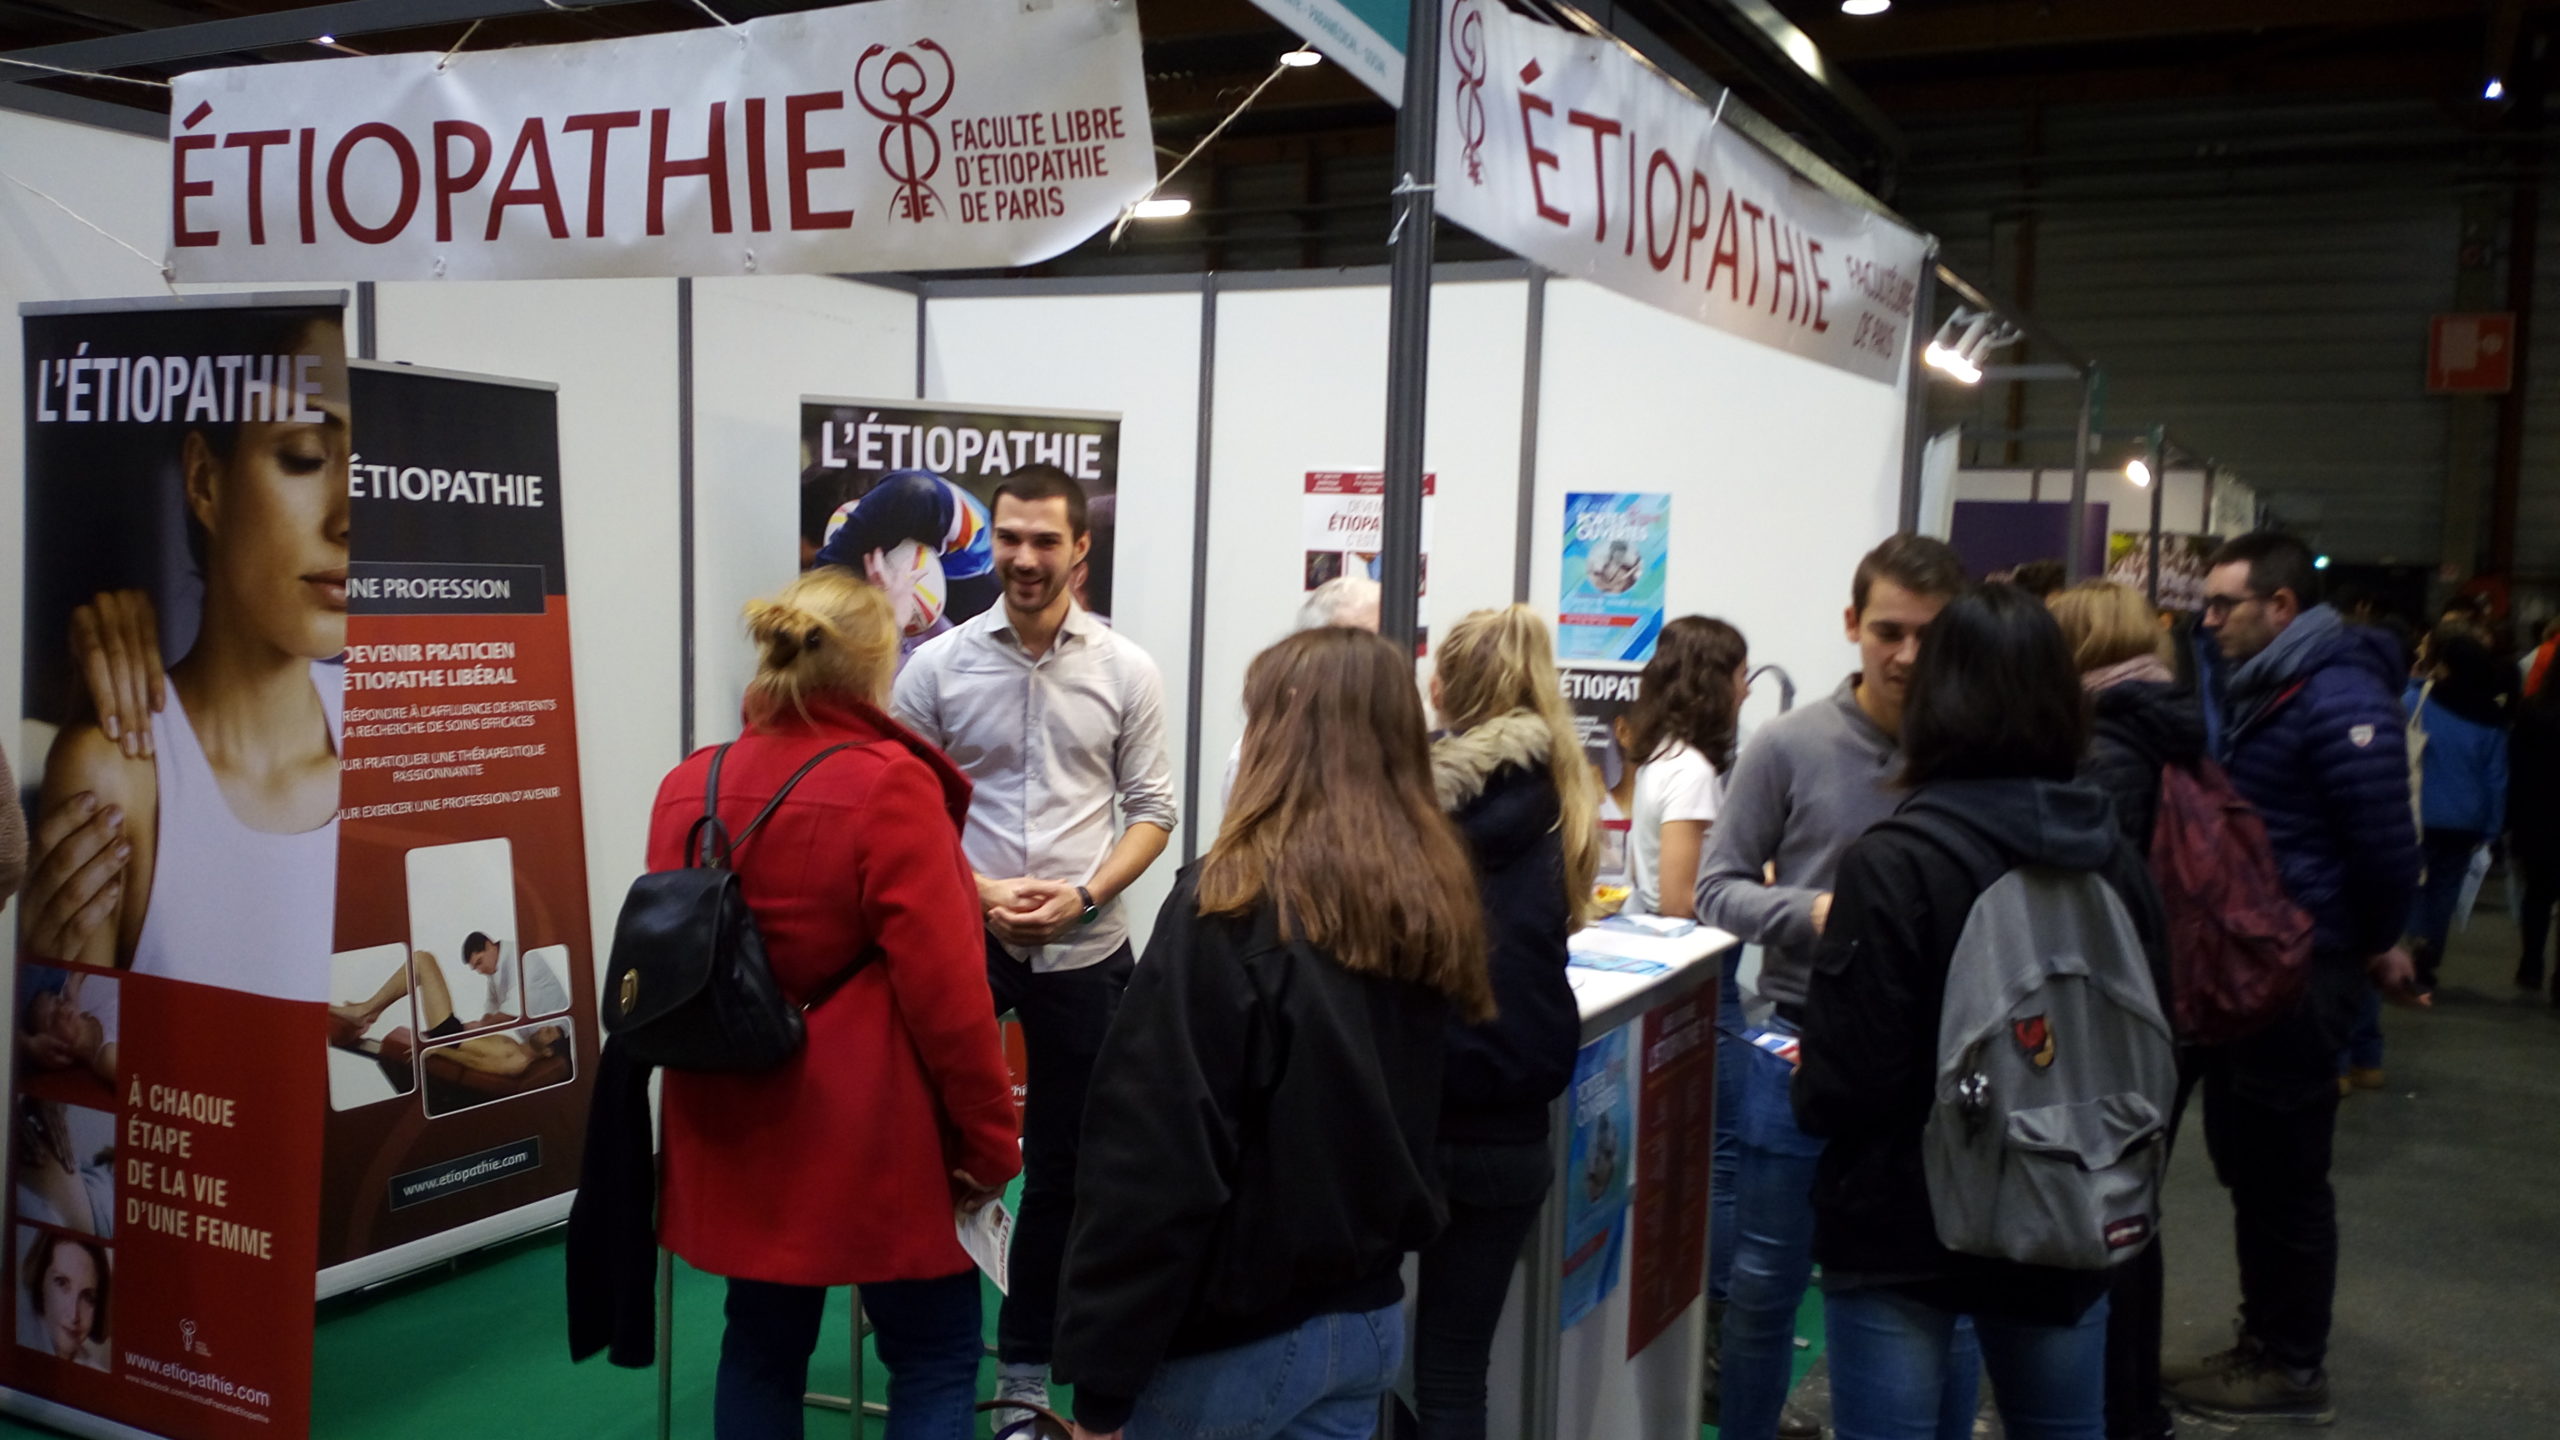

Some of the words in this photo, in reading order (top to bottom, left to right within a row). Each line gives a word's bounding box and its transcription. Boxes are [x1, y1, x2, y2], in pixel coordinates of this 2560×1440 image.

[1052, 106, 1125, 145] LIBRE
[173, 91, 855, 247] ÉTIOPATHIE
[960, 191, 989, 223] DE
[995, 186, 1065, 221] PARIS
[1518, 58, 1830, 333] ÉTIOPATHIE
[36, 342, 325, 424] L'ÉTIOPATHIE
[821, 411, 1102, 480] L'ÉTIOPATHIE
[1328, 511, 1381, 532] ÉTIOPA
[383, 577, 511, 600] PROFESSION
[425, 642, 516, 661] PRATICIEN
[447, 663, 518, 687] LIBÉRAL
[1559, 669, 1643, 702] ÉTIOPAT
[343, 707, 408, 722] RÉPONDRE
[493, 701, 509, 714] DE
[509, 699, 558, 713] PATIENTS
[356, 721, 425, 738] RECHERCHE
[427, 720, 444, 733] DE
[445, 718, 480, 732] SOINS
[481, 714, 536, 730] EFFICACES
[363, 753, 430, 769] PRATIQUER
[431, 750, 457, 764] UNE
[457, 743, 547, 761] THÉRAPEUTIQUE
[392, 763, 485, 783] PASSIONNANTE
[362, 801, 413, 819] EXERCER
[414, 798, 442, 812] UNE
[442, 792, 511, 810] PROFESSION
[149, 1084, 236, 1128] CHAQUE
[127, 1112, 192, 1159] ÉTAPE
[127, 1158, 155, 1190] DE
[160, 1166, 187, 1199] LA
[192, 1173, 228, 1208] VIE
[402, 1151, 529, 1197] www.etiopathie.com
[126, 1197, 189, 1239] D'UNE
[195, 1214, 273, 1261] FEMME
[125, 1351, 271, 1407] www.etiopathie.com
